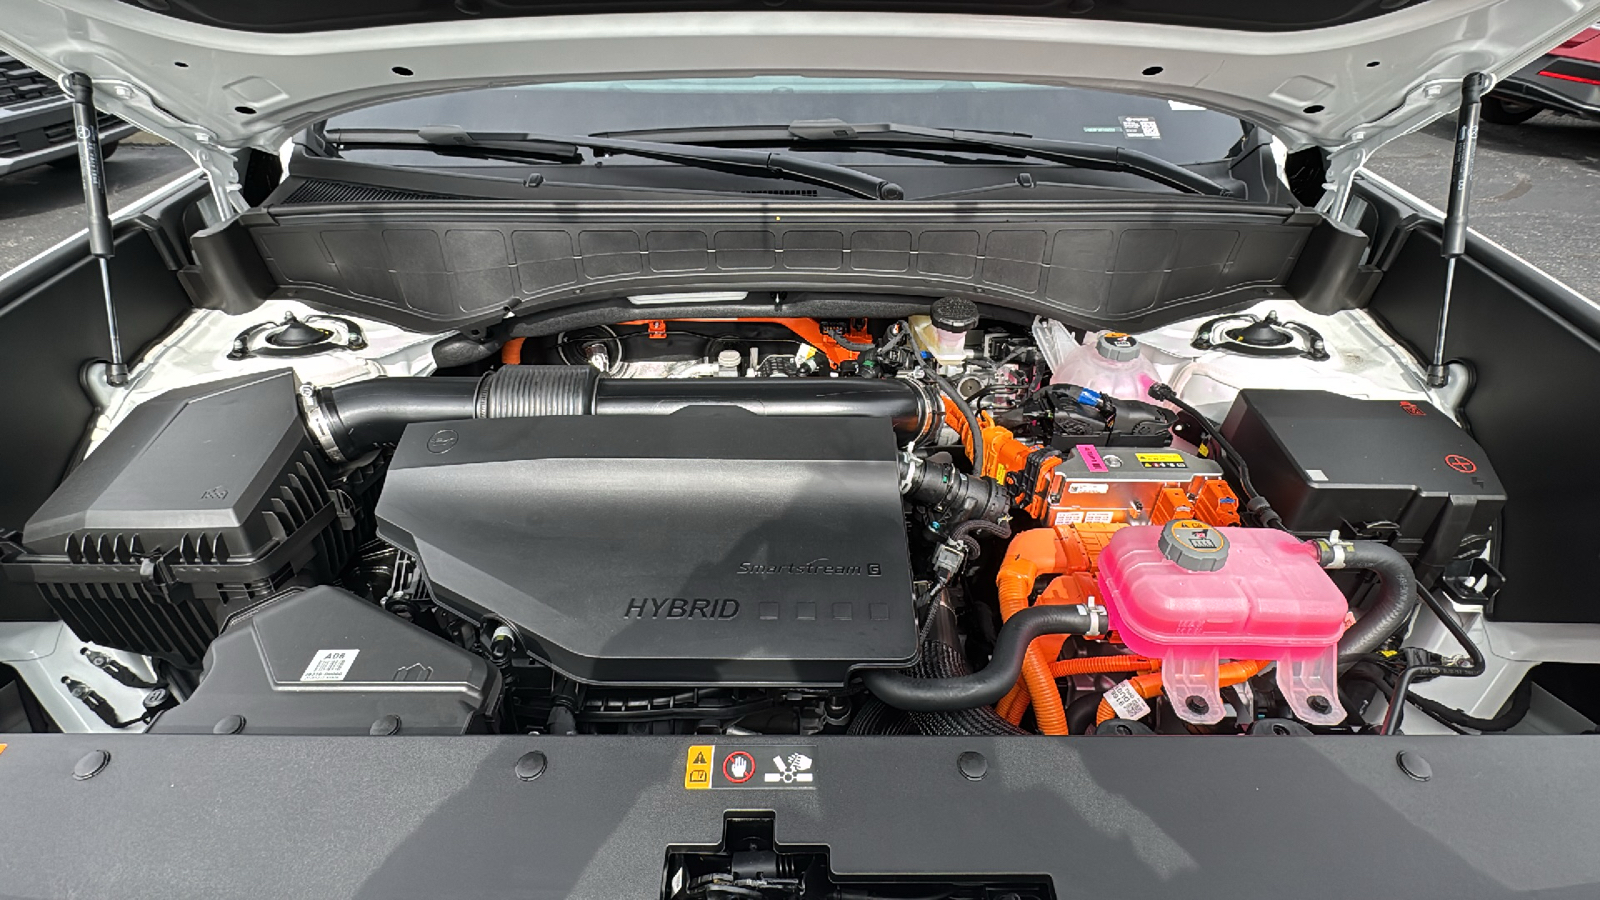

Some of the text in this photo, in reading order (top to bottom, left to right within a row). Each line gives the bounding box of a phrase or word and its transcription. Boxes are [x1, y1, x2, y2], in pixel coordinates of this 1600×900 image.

[737, 558, 882, 577] Smartstream G
[623, 597, 740, 621] HYBRID
